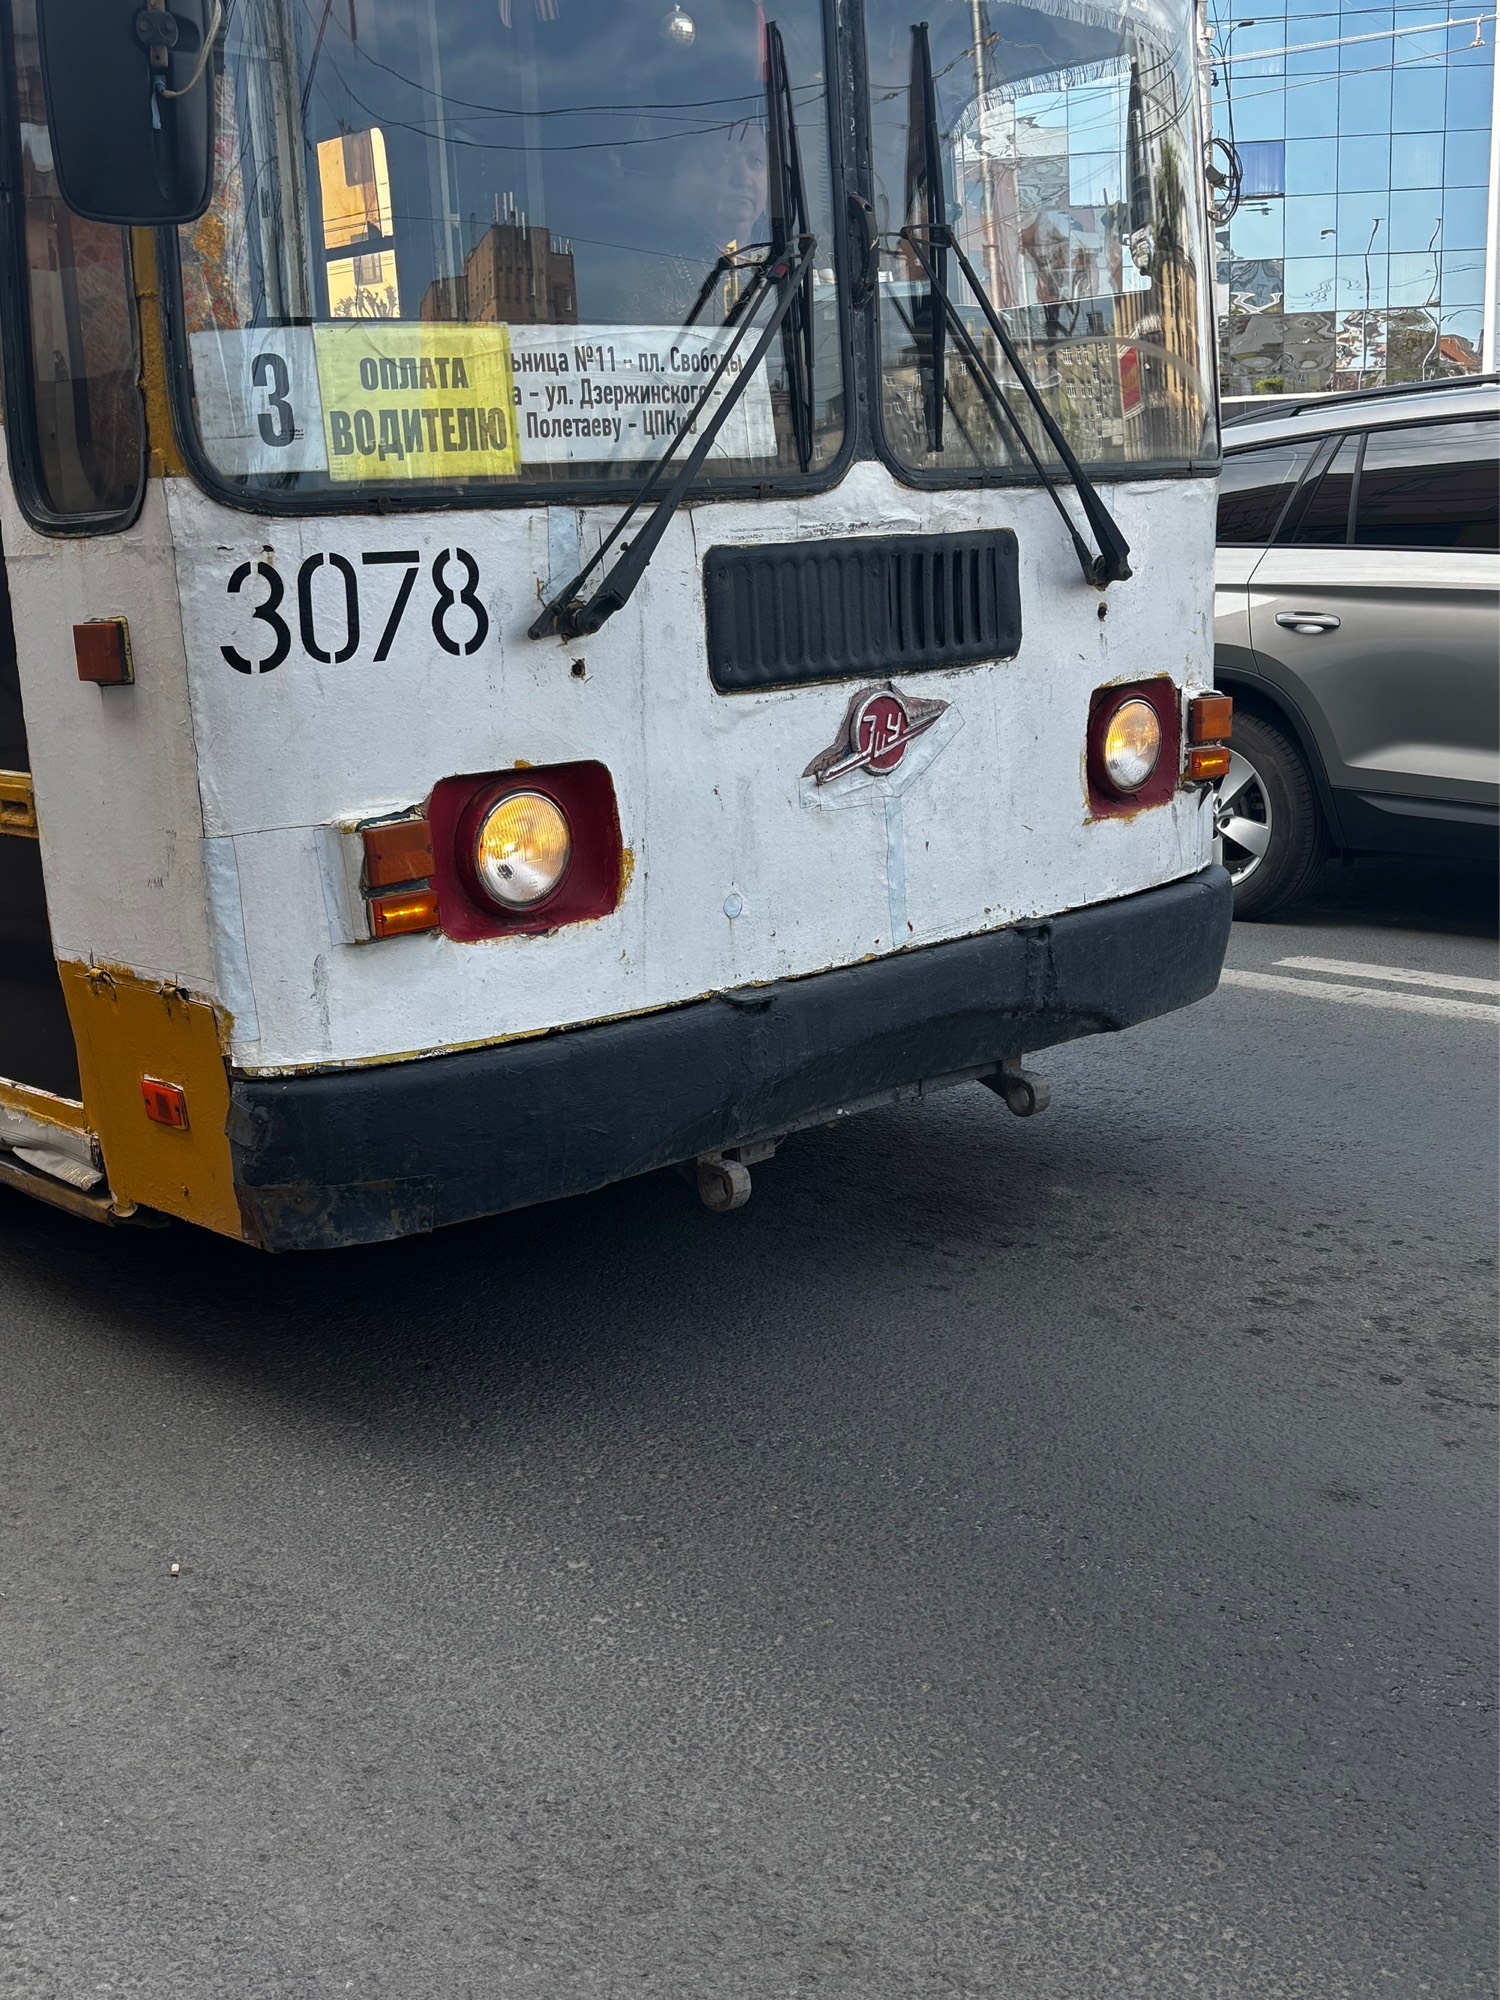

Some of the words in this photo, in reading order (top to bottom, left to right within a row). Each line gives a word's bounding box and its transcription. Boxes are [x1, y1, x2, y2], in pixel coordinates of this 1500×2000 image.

[359, 356, 470, 391] ОПЛАТА
[505, 352, 569, 376] ьница
[638, 353, 665, 372] пл.
[251, 352, 295, 448] 3
[545, 385, 574, 412] ул.
[329, 406, 508, 462] ВОДИТЕЛЮ
[526, 412, 621, 443] Полетаеву
[220, 547, 489, 675] 3078
